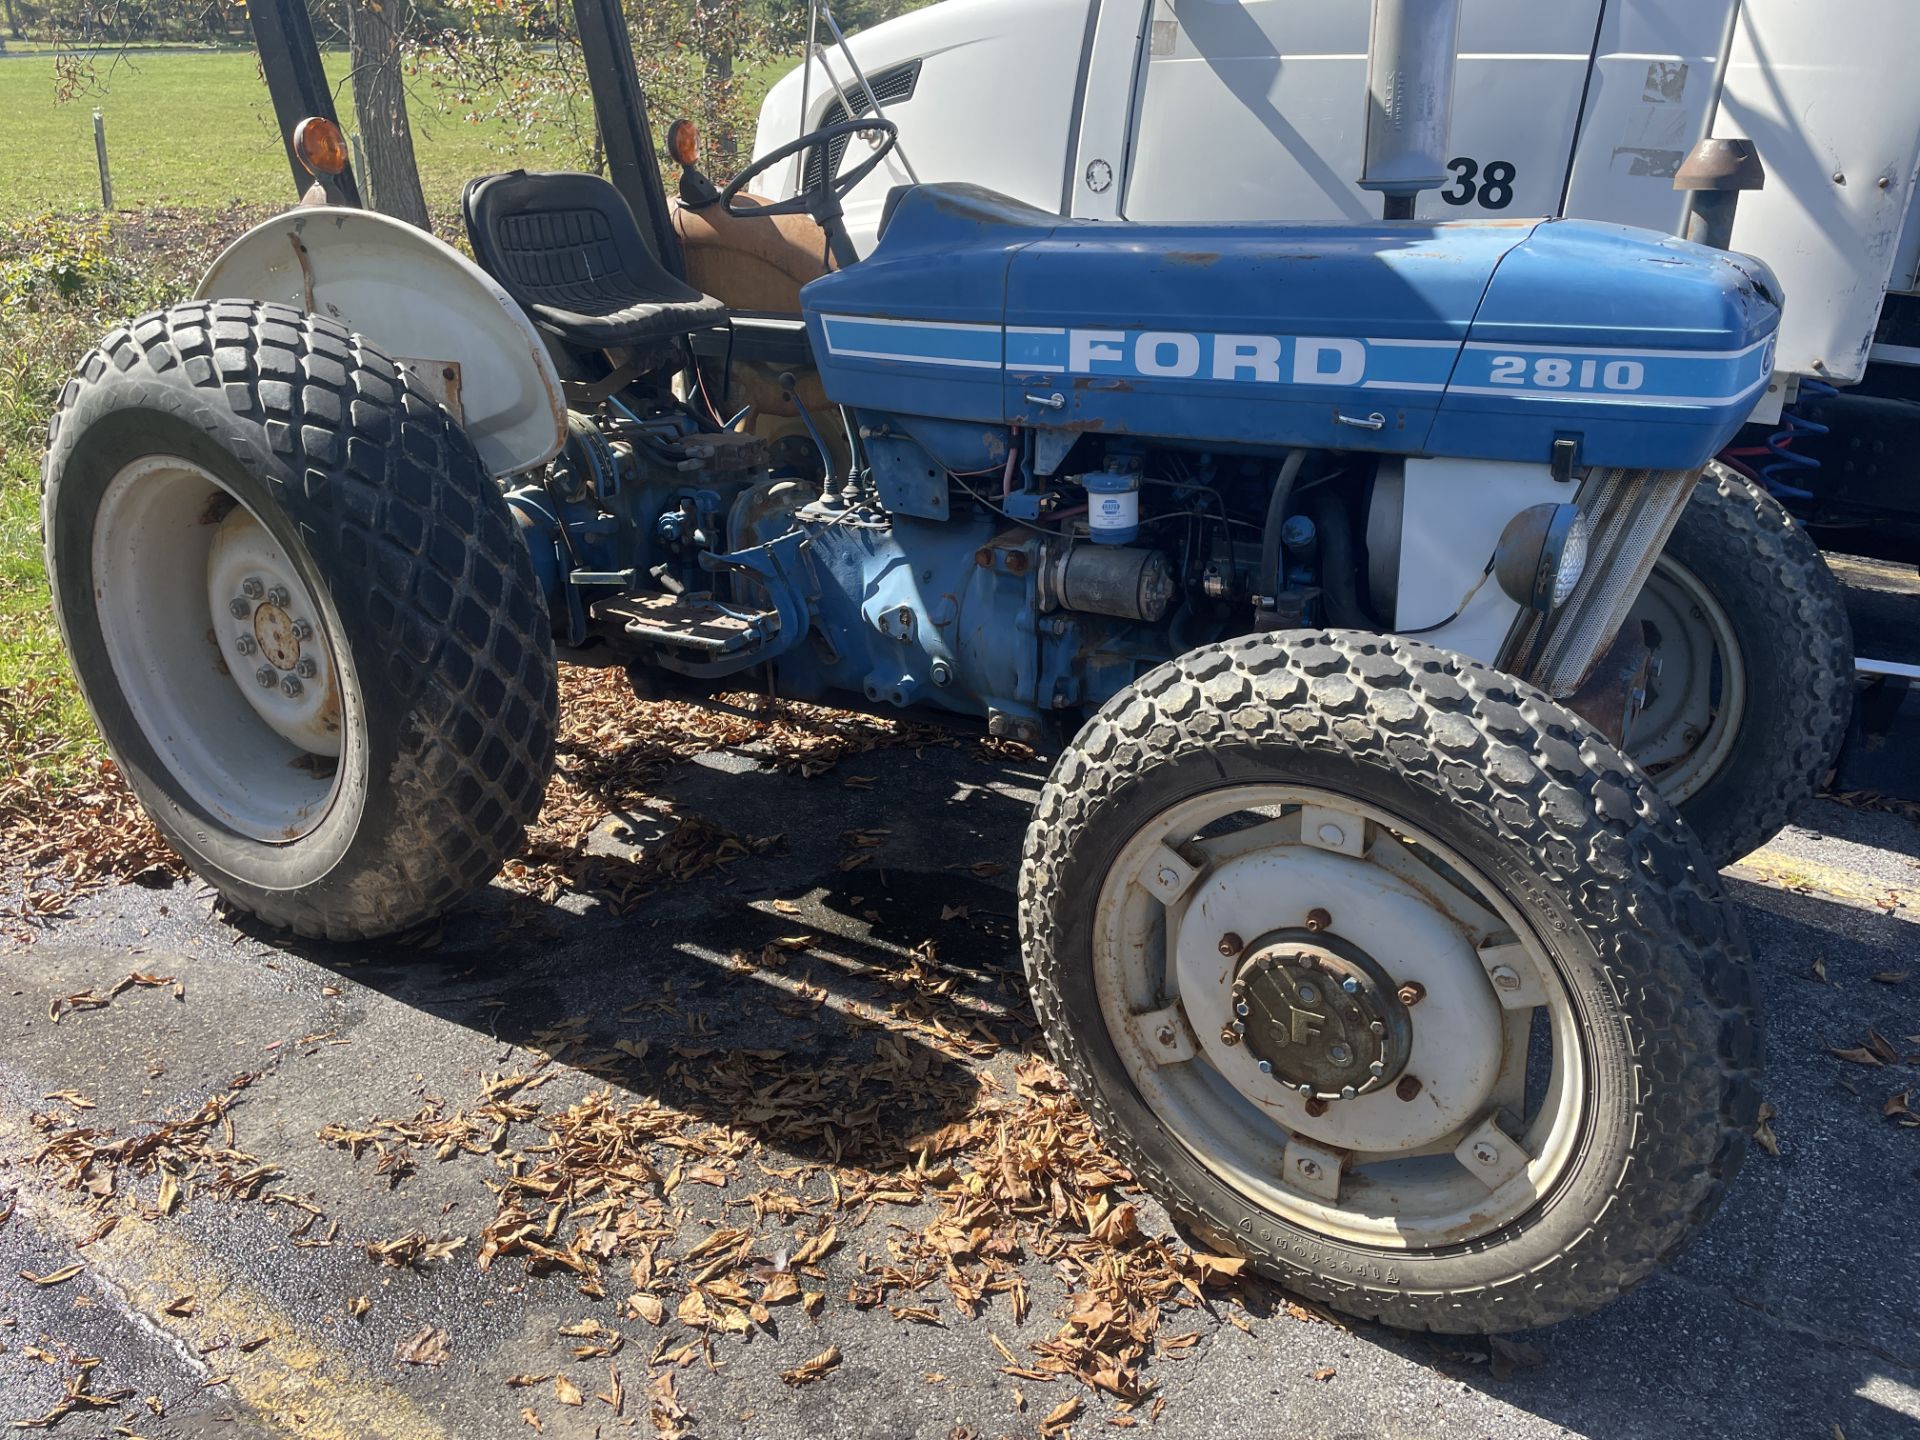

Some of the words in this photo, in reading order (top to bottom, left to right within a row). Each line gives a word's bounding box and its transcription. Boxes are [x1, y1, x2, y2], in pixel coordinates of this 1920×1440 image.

[1441, 157, 1516, 210] 38
[1069, 329, 1366, 386] FORD
[1489, 356, 1645, 390] 2810
